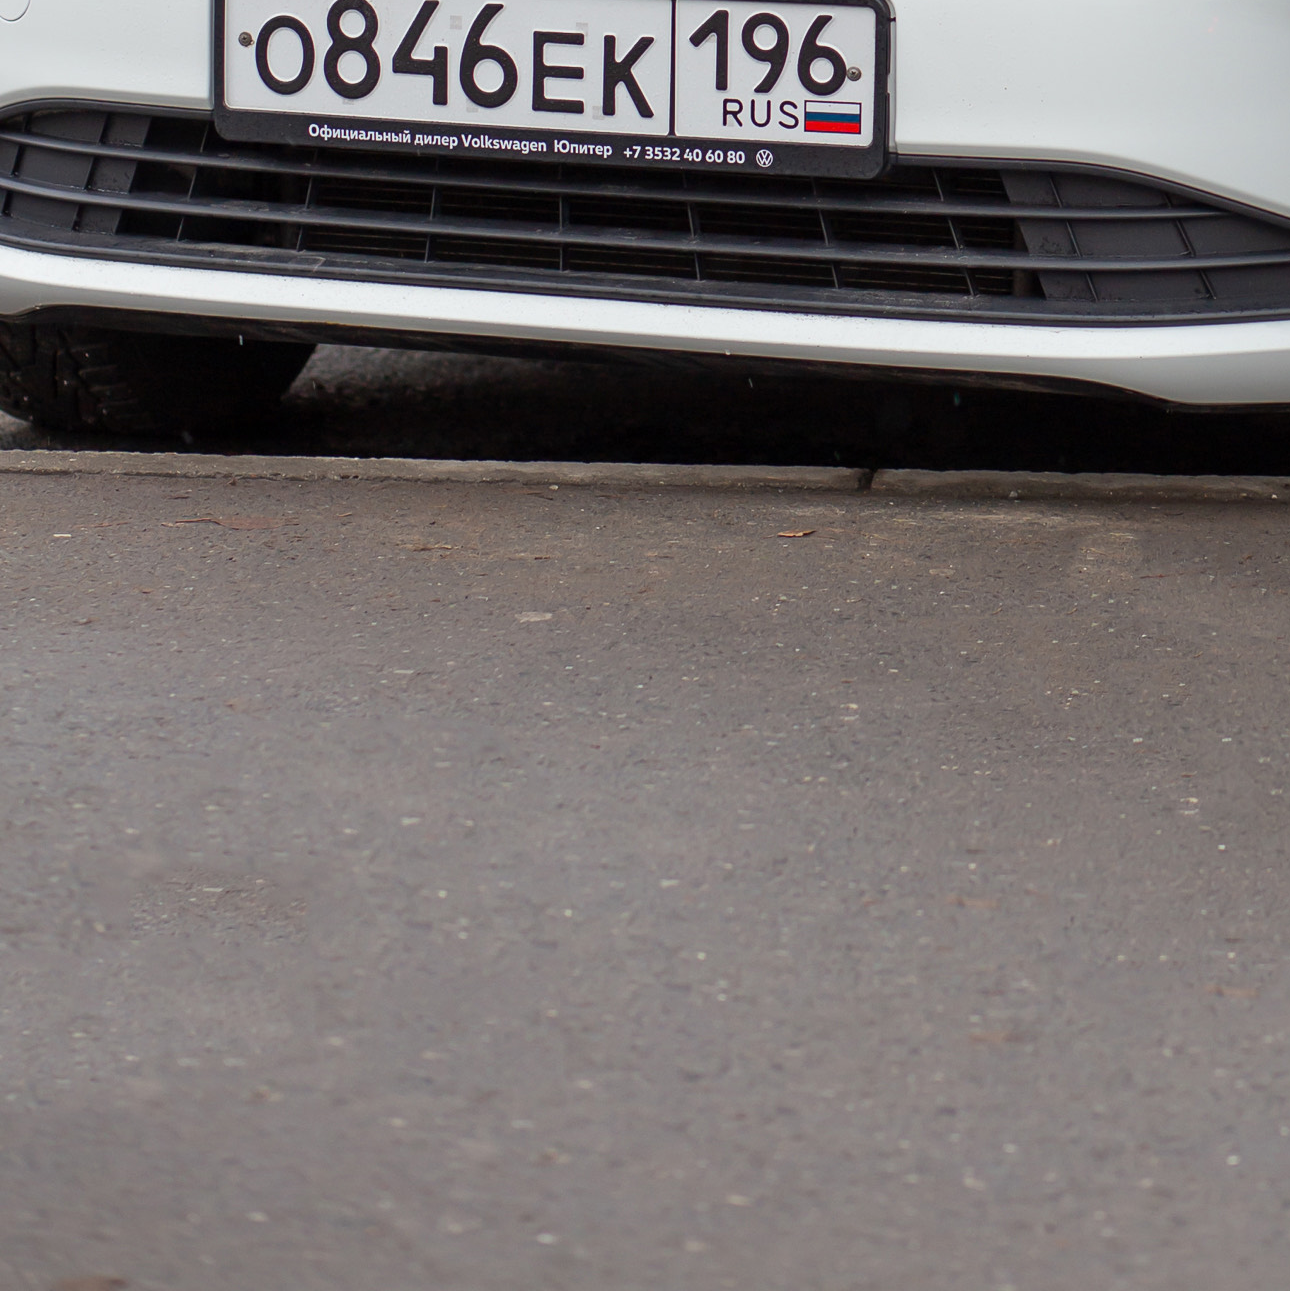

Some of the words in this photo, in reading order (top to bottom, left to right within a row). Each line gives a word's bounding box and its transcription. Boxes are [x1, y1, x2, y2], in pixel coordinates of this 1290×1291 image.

[687, 9, 848, 97] 196
[722, 98, 799, 128] RUS
[308, 123, 412, 145] Официальный
[414, 133, 459, 150] дилер
[461, 133, 547, 155] Volkswagen
[553, 139, 613, 159] Юпитер
[623, 145, 642, 159] +7
[644, 146, 681, 161] 3532
[683, 149, 703, 163] 40
[705, 149, 724, 163] 60
[726, 150, 746, 164] 80
